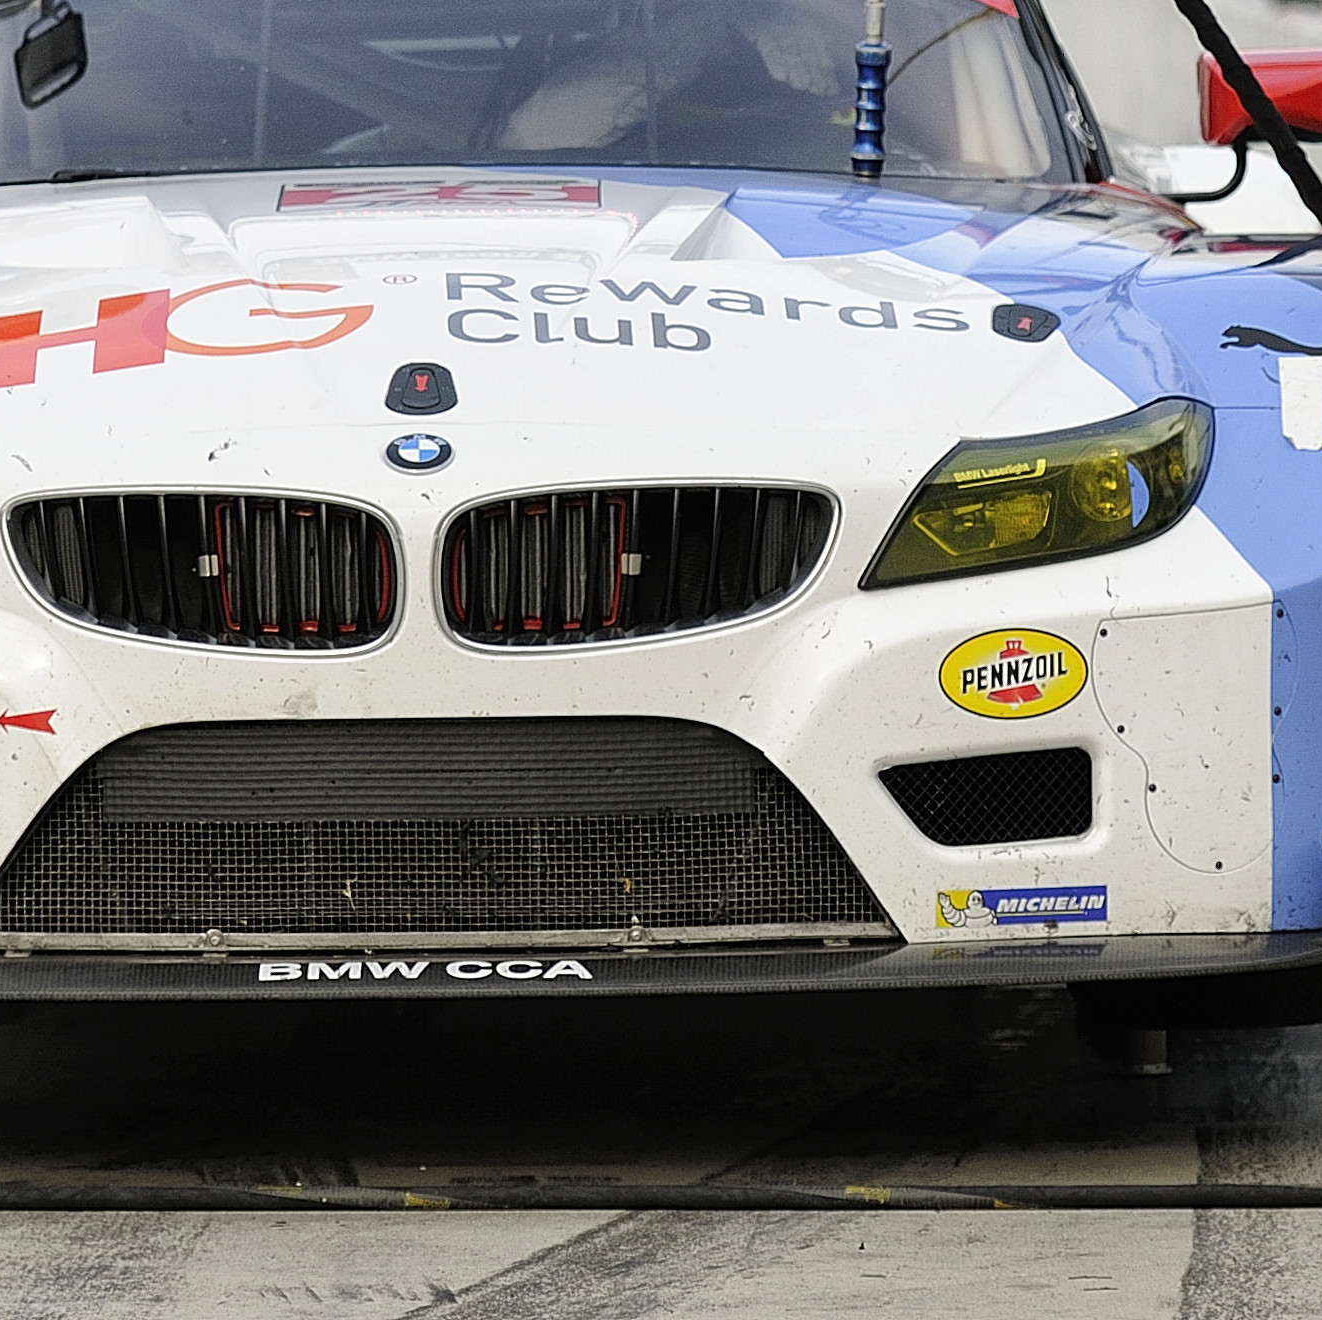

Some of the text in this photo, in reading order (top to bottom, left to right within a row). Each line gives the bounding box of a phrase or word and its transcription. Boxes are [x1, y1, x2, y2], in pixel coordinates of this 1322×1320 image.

[445, 271, 971, 334] Rewards
[446, 309, 713, 352] Club
[961, 651, 1068, 695] PENNZOIL
[997, 894, 1106, 913] MICHELIN
[258, 959, 594, 981] BMW CCA
